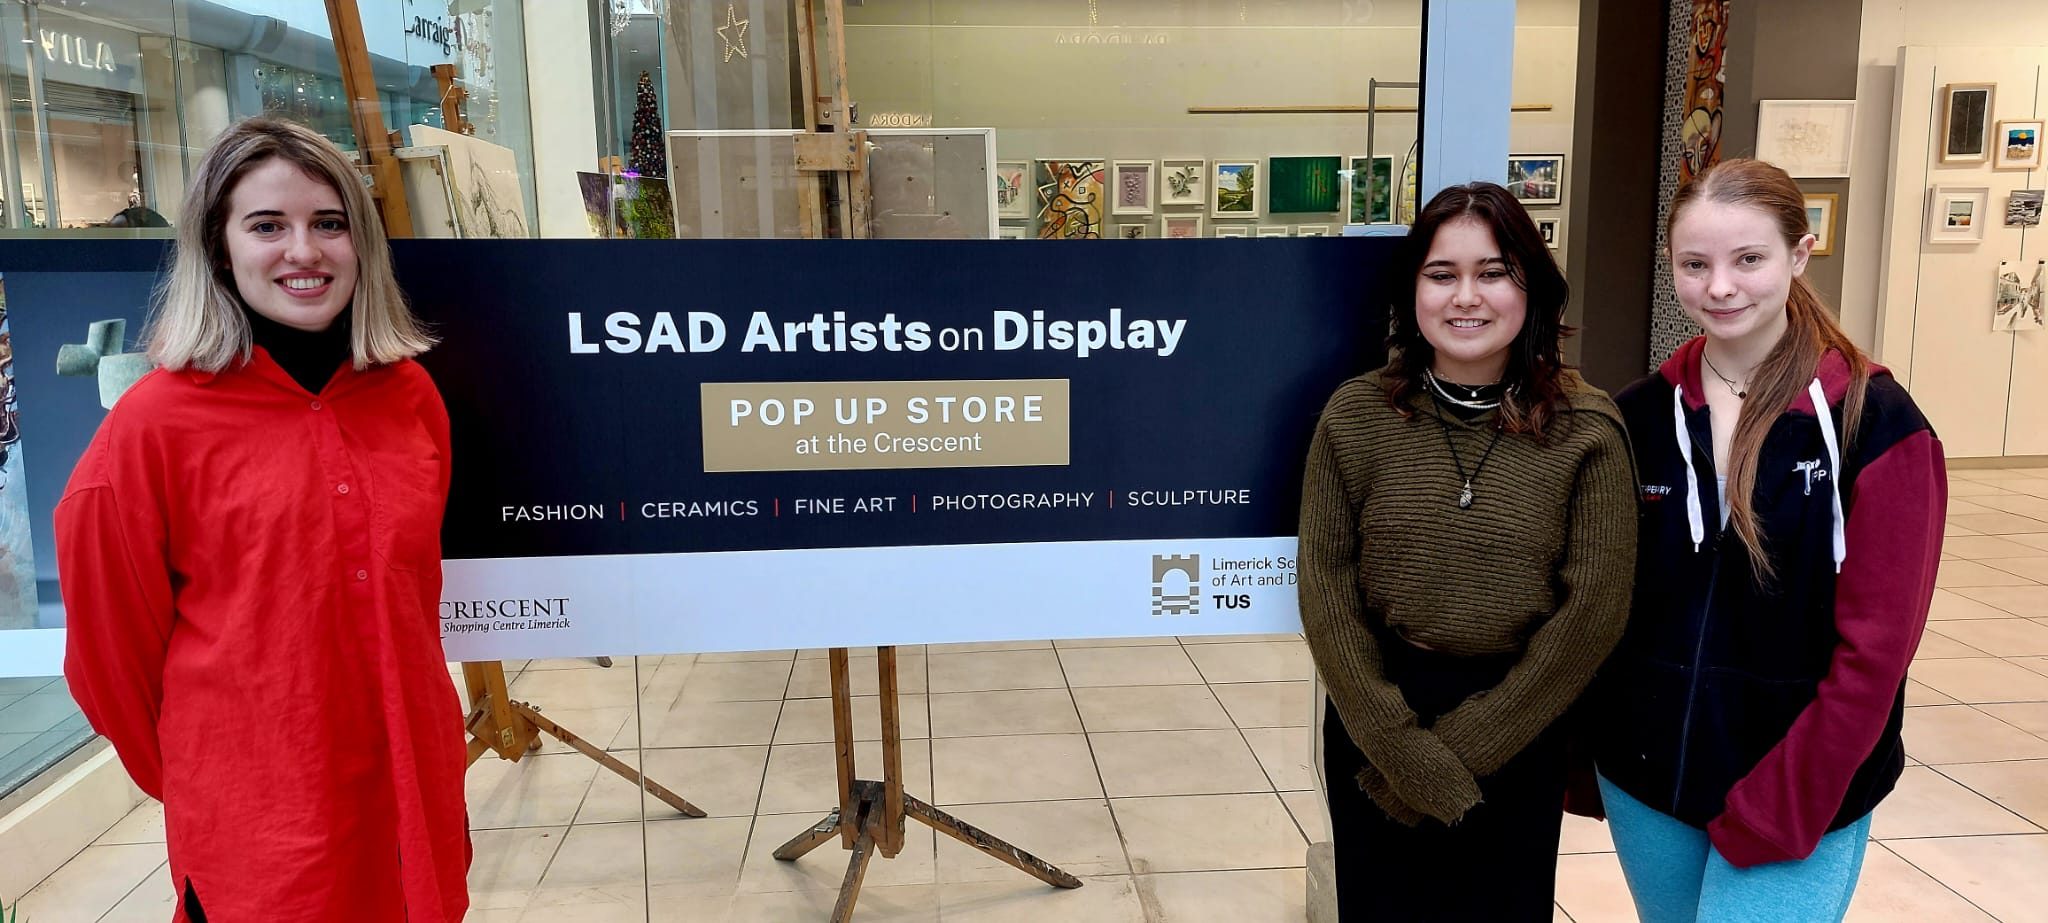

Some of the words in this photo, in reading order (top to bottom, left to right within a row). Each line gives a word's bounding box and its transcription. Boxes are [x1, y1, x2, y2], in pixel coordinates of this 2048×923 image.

[568, 311, 727, 354] LSAD
[741, 311, 932, 352] Artists
[939, 327, 984, 351] on
[994, 308, 1187, 358] Display
[731, 398, 815, 426] POP
[835, 398, 888, 425] UP
[907, 395, 1043, 424] STORE
[796, 435, 819, 454] at
[827, 433, 867, 453] the
[874, 432, 982, 452] Crescent
[502, 504, 604, 522] FASHION
[641, 500, 759, 518] CERAMICS
[795, 498, 845, 515] FINE
[853, 497, 897, 513] ART
[933, 492, 1095, 511] PHOTOGRAPHY
[1127, 489, 1251, 506] SCULPTURE
[1212, 556, 1272, 570] Limerick
[1277, 556, 1298, 570] Sc
[1212, 574, 1226, 587] of
[1231, 573, 1253, 586] Art
[1257, 572, 1283, 586] and
[1212, 594, 1251, 609] TUS
[443, 621, 490, 633] Shopping
[492, 619, 525, 631] Centre
[528, 618, 571, 630] Limerick
